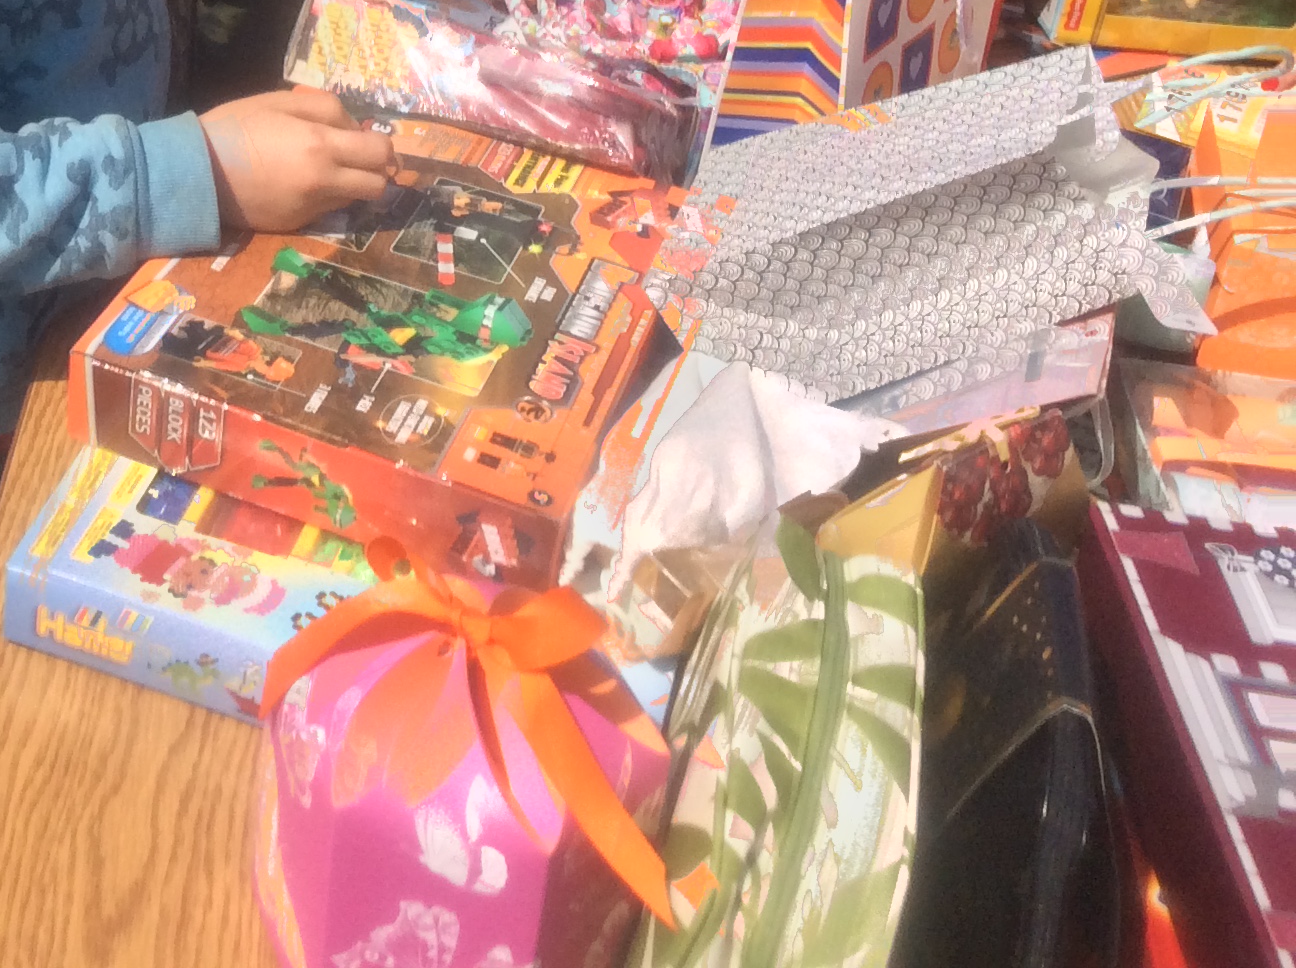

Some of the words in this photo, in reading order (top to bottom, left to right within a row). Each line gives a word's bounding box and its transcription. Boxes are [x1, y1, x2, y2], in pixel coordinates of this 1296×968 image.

[135, 385, 153, 436] PIECES
[166, 396, 185, 443] BLOCK
[196, 407, 217, 441] 123
